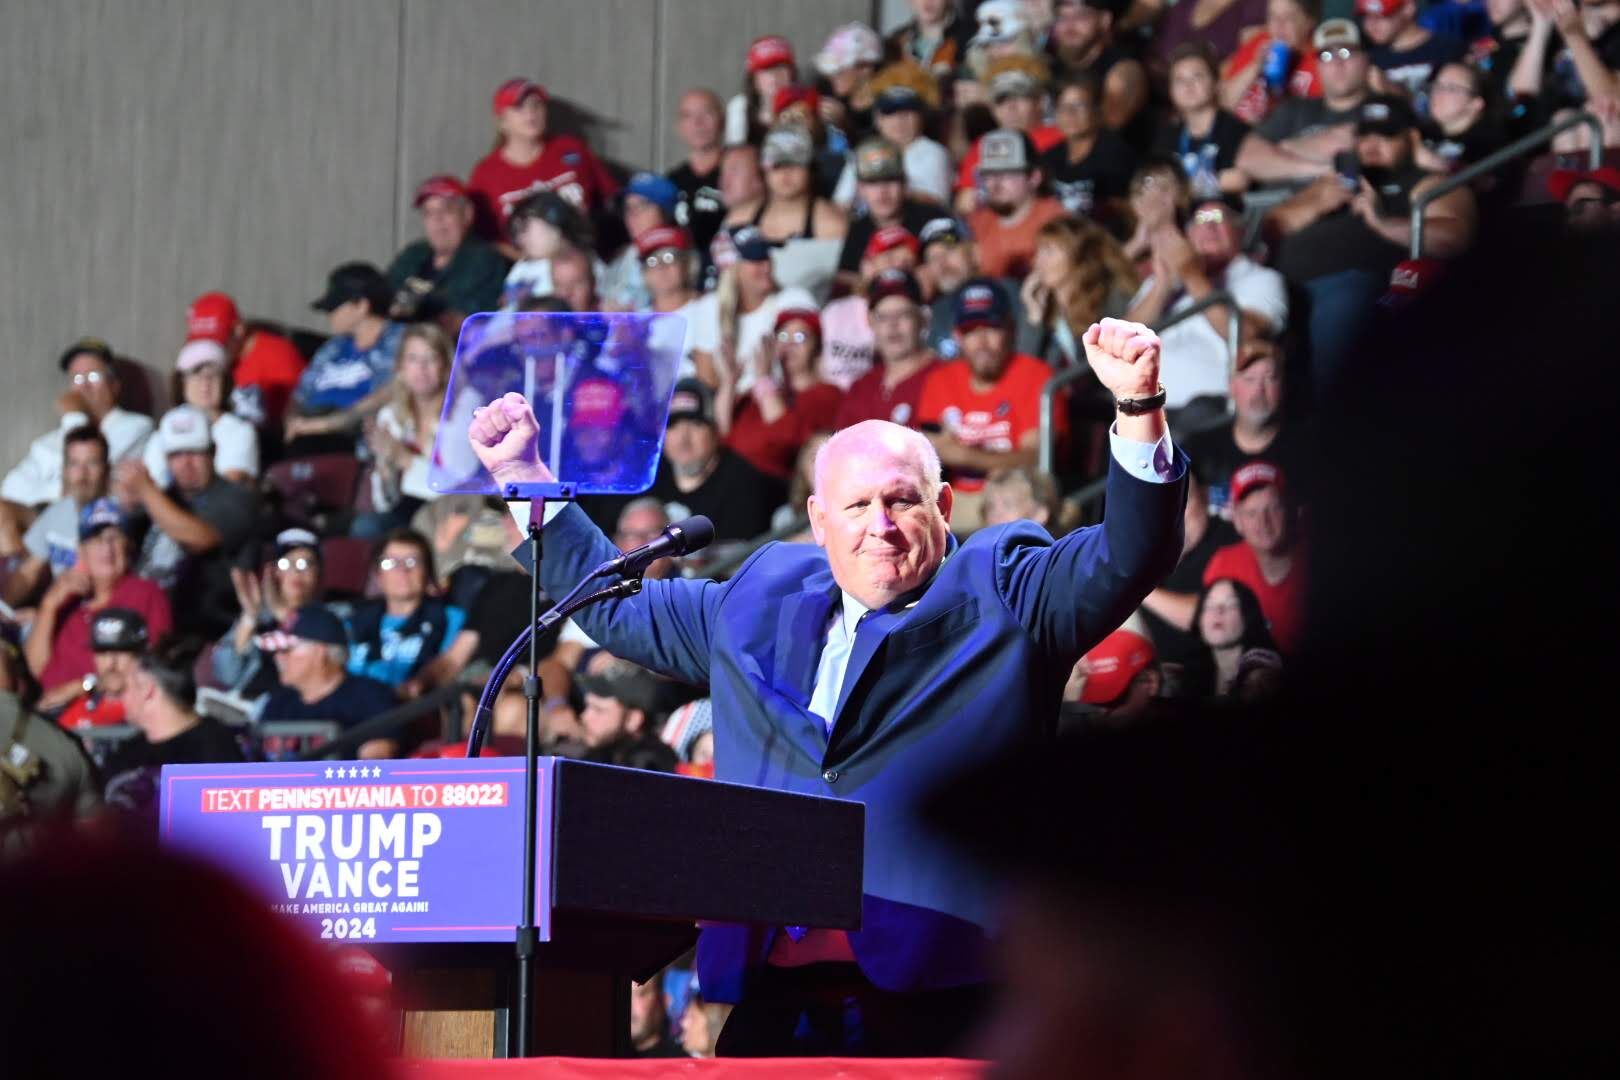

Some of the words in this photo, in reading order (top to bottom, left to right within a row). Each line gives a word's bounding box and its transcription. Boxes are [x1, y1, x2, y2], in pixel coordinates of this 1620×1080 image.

[206, 789, 255, 811] TEXT
[258, 786, 406, 810] PENNSYLVANIA
[410, 785, 438, 806] TO
[441, 783, 504, 807] 88022
[262, 812, 442, 860] TRUMP
[280, 860, 420, 899] VANCE
[302, 903, 350, 914] AMERICA
[353, 902, 388, 913] GREAT
[390, 901, 430, 913] AGAIN!
[320, 917, 377, 939] 2024
